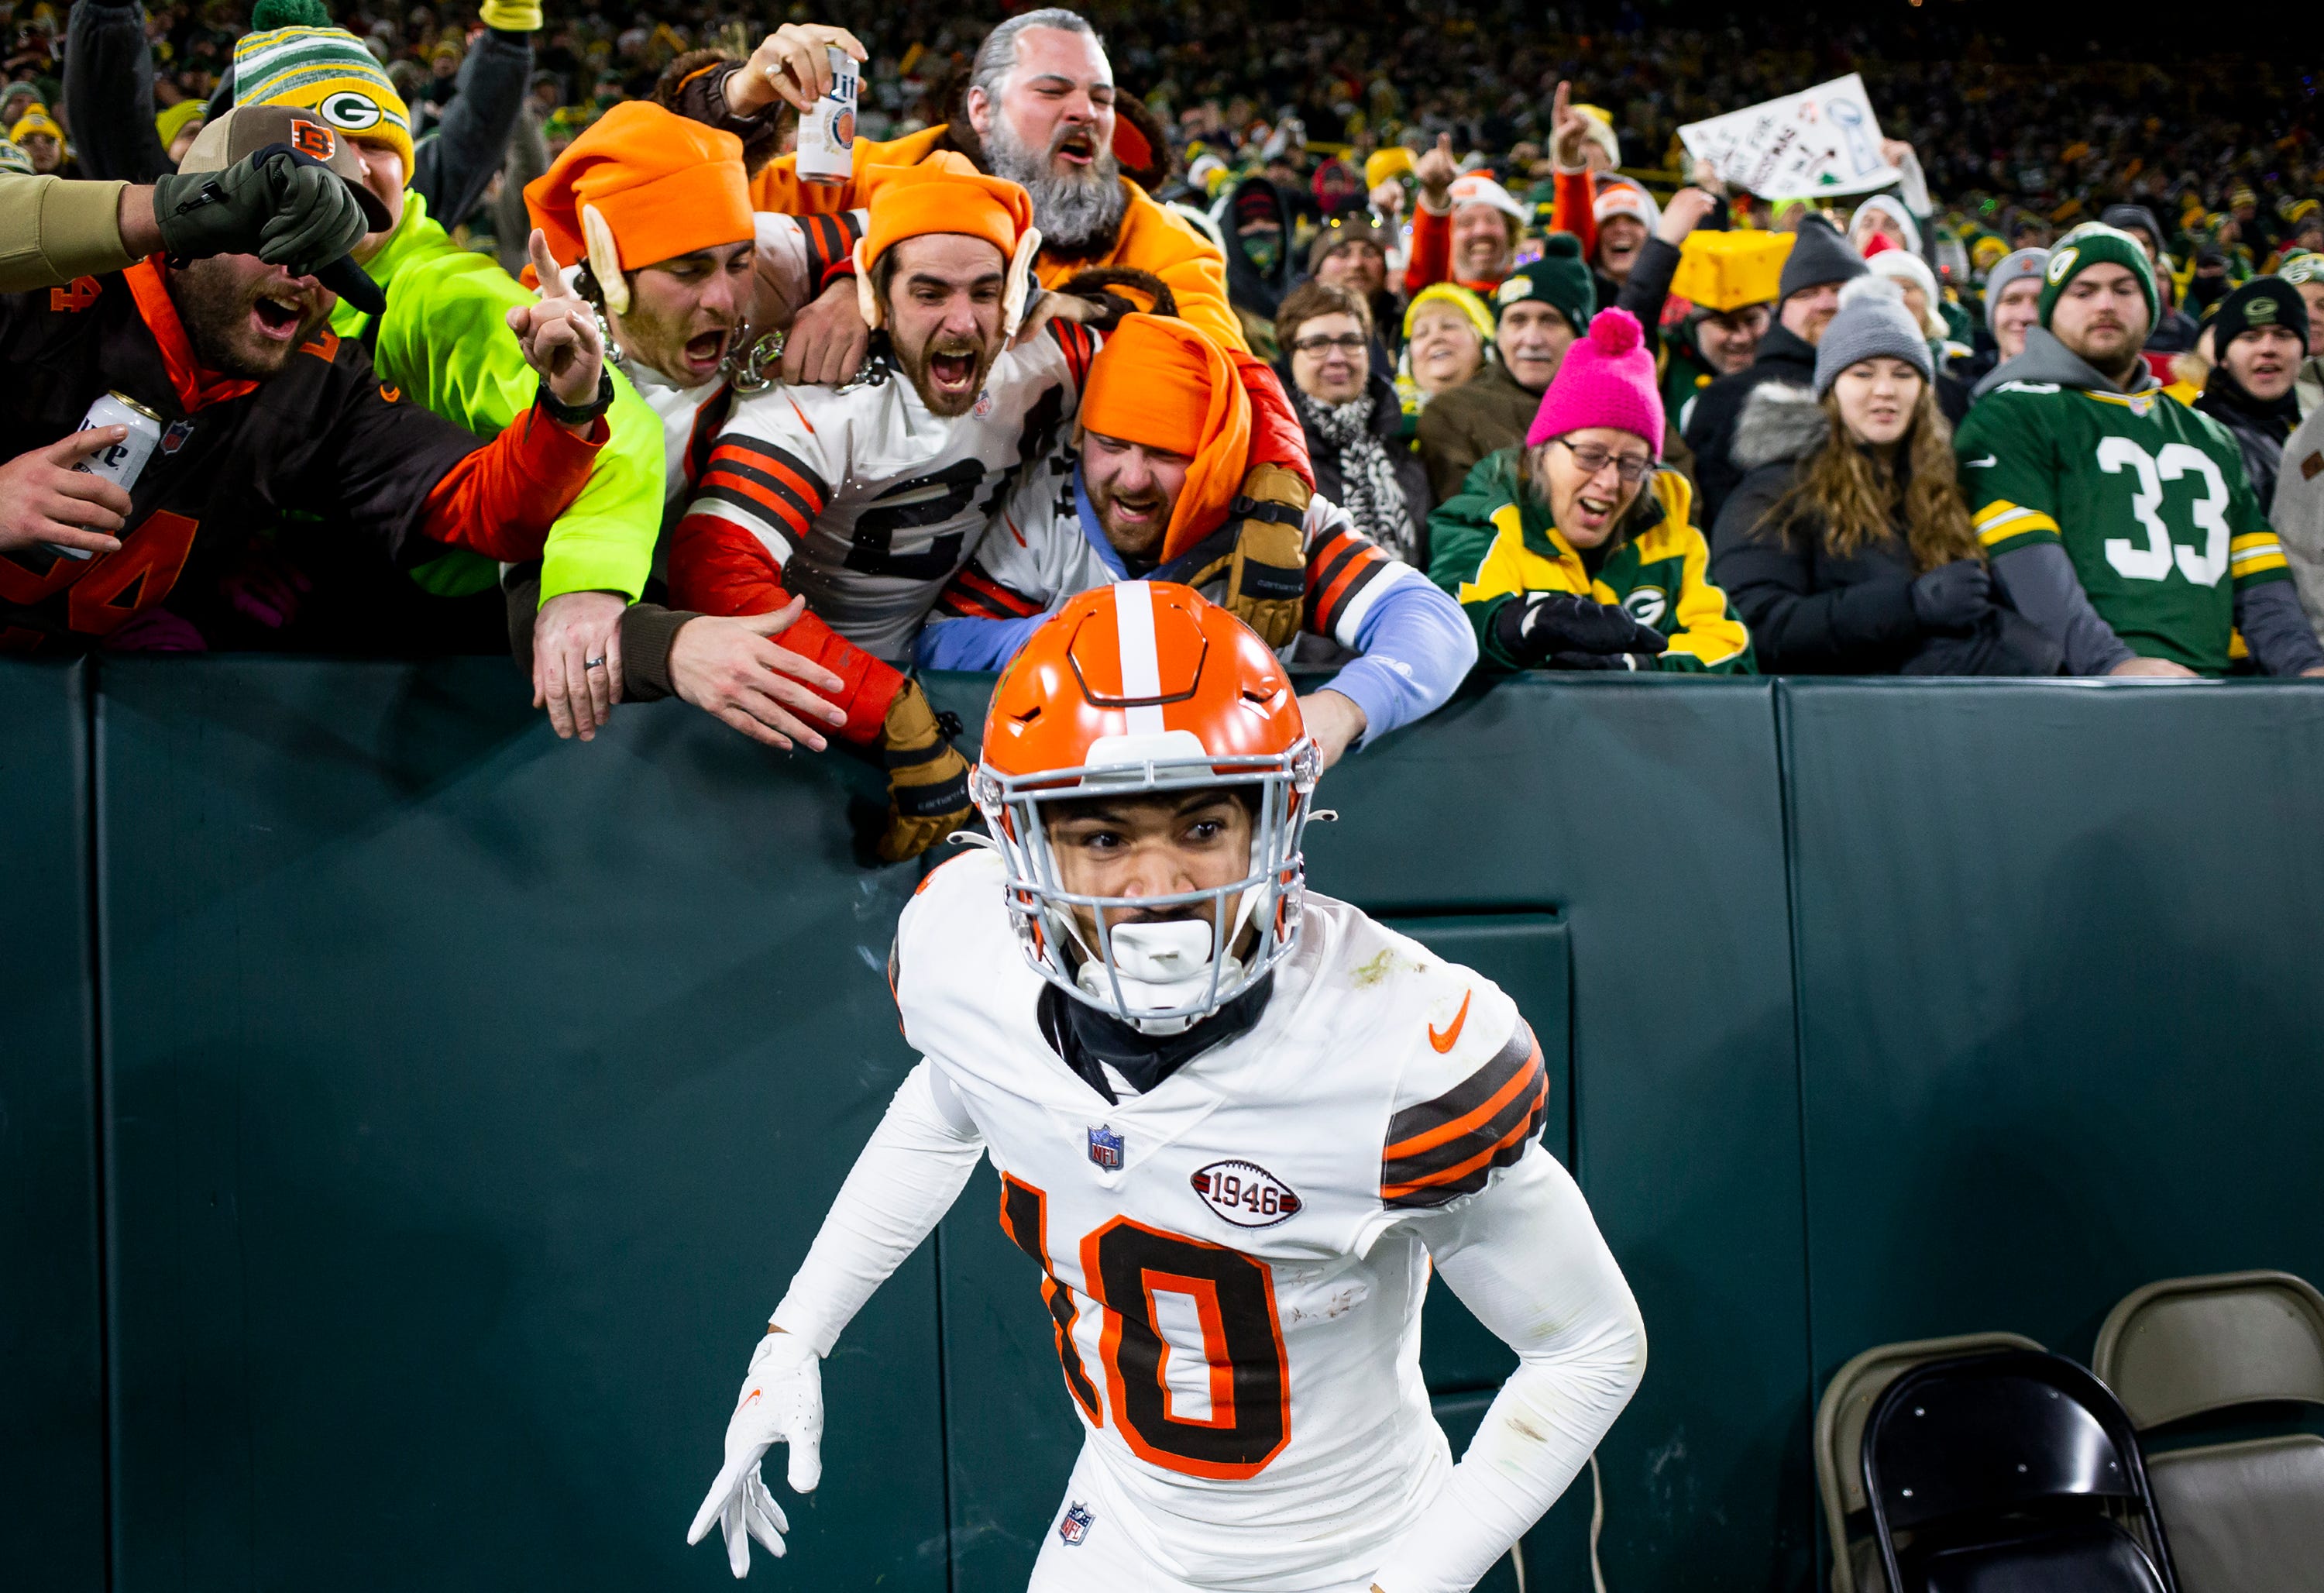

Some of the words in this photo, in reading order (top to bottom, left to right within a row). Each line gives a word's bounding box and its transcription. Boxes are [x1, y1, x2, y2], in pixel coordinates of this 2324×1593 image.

[830, 72, 855, 104] Lit
[321, 92, 380, 130] G
[2096, 436, 2232, 587] 33
[1623, 589, 1666, 626] G
[1092, 1144, 1118, 1165] NFL
[1212, 1172, 1279, 1216] 1946
[999, 1171, 1291, 1481] 10
[1061, 1517, 1081, 1540] NFL
